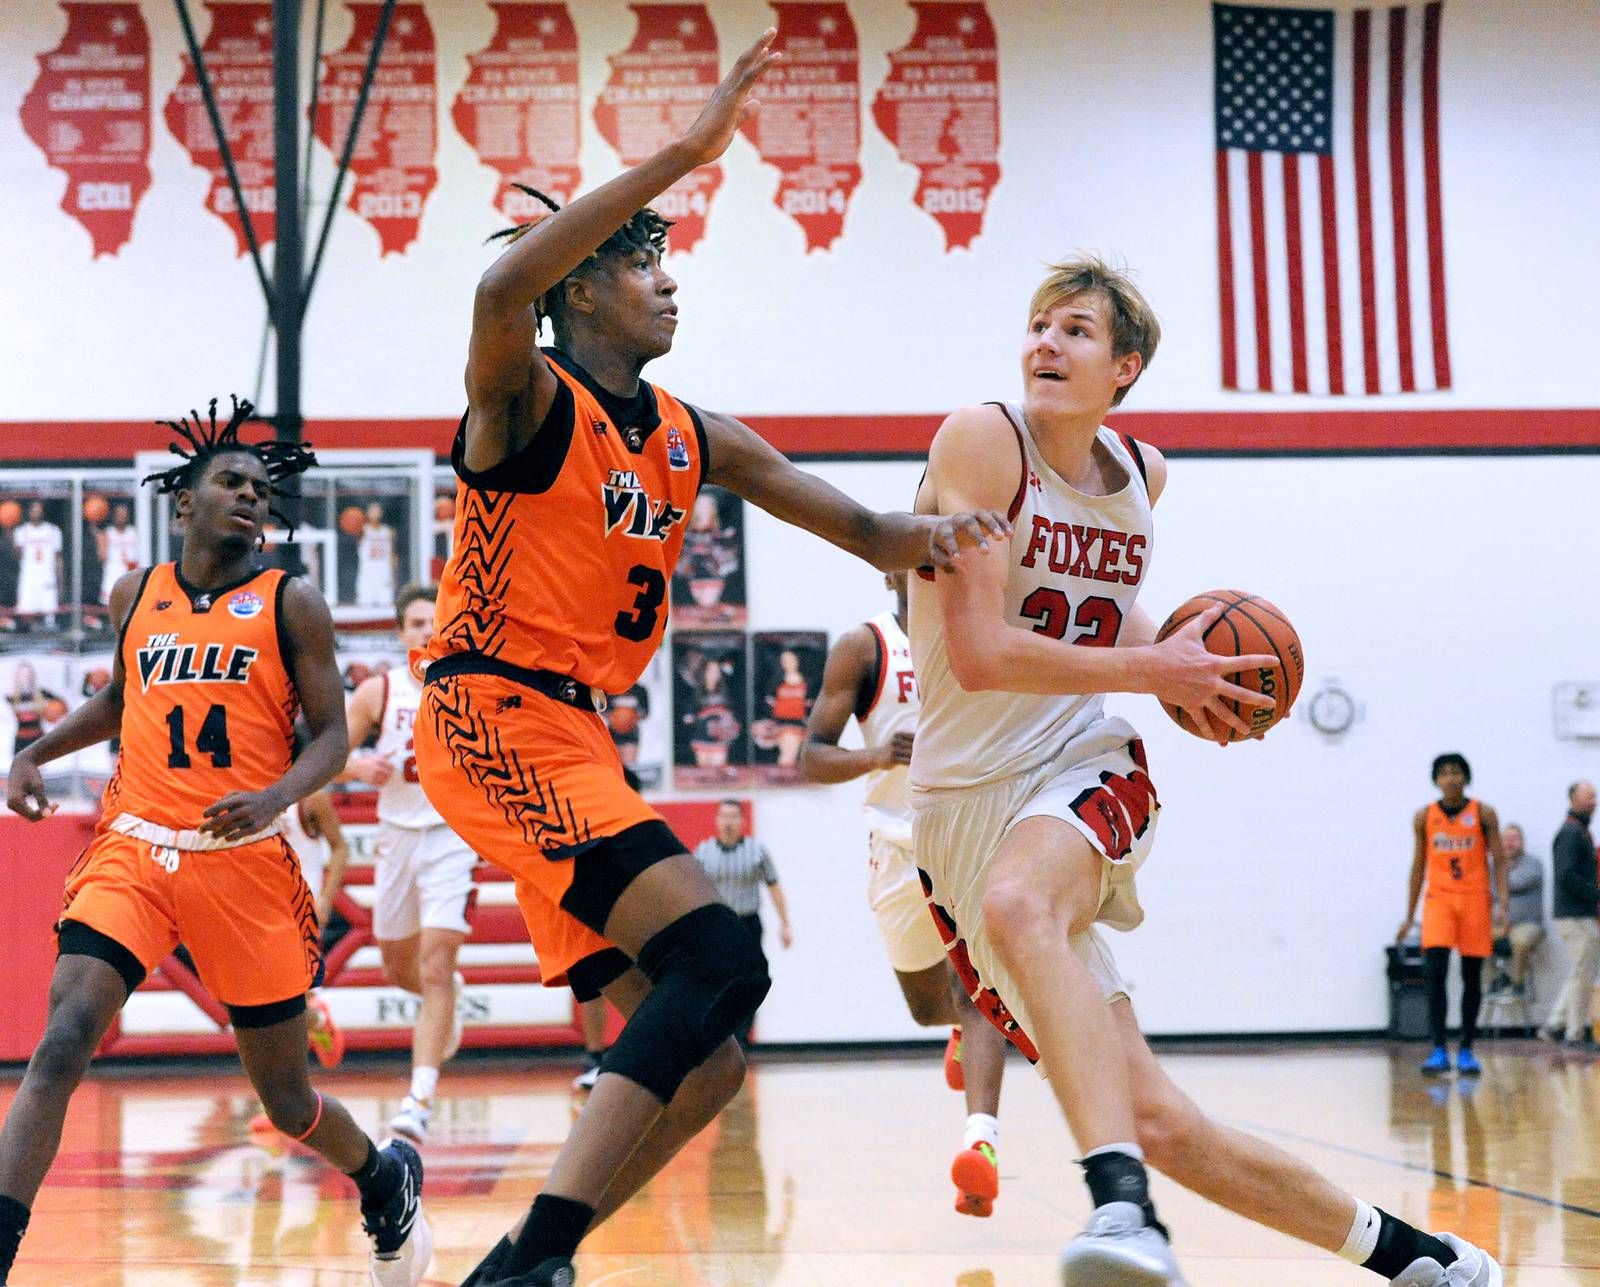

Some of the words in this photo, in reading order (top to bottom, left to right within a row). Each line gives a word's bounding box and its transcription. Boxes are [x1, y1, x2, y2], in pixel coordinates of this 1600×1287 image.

[77, 183, 132, 209] 2011
[359, 193, 421, 217] 2013
[648, 191, 706, 217] 014
[783, 189, 846, 214] 2014
[922, 188, 985, 213] 2015
[1020, 514, 1147, 586] FOXES
[614, 564, 669, 643] 3
[147, 632, 180, 646] THE
[136, 643, 259, 695] VILLE
[165, 704, 232, 769] 14
